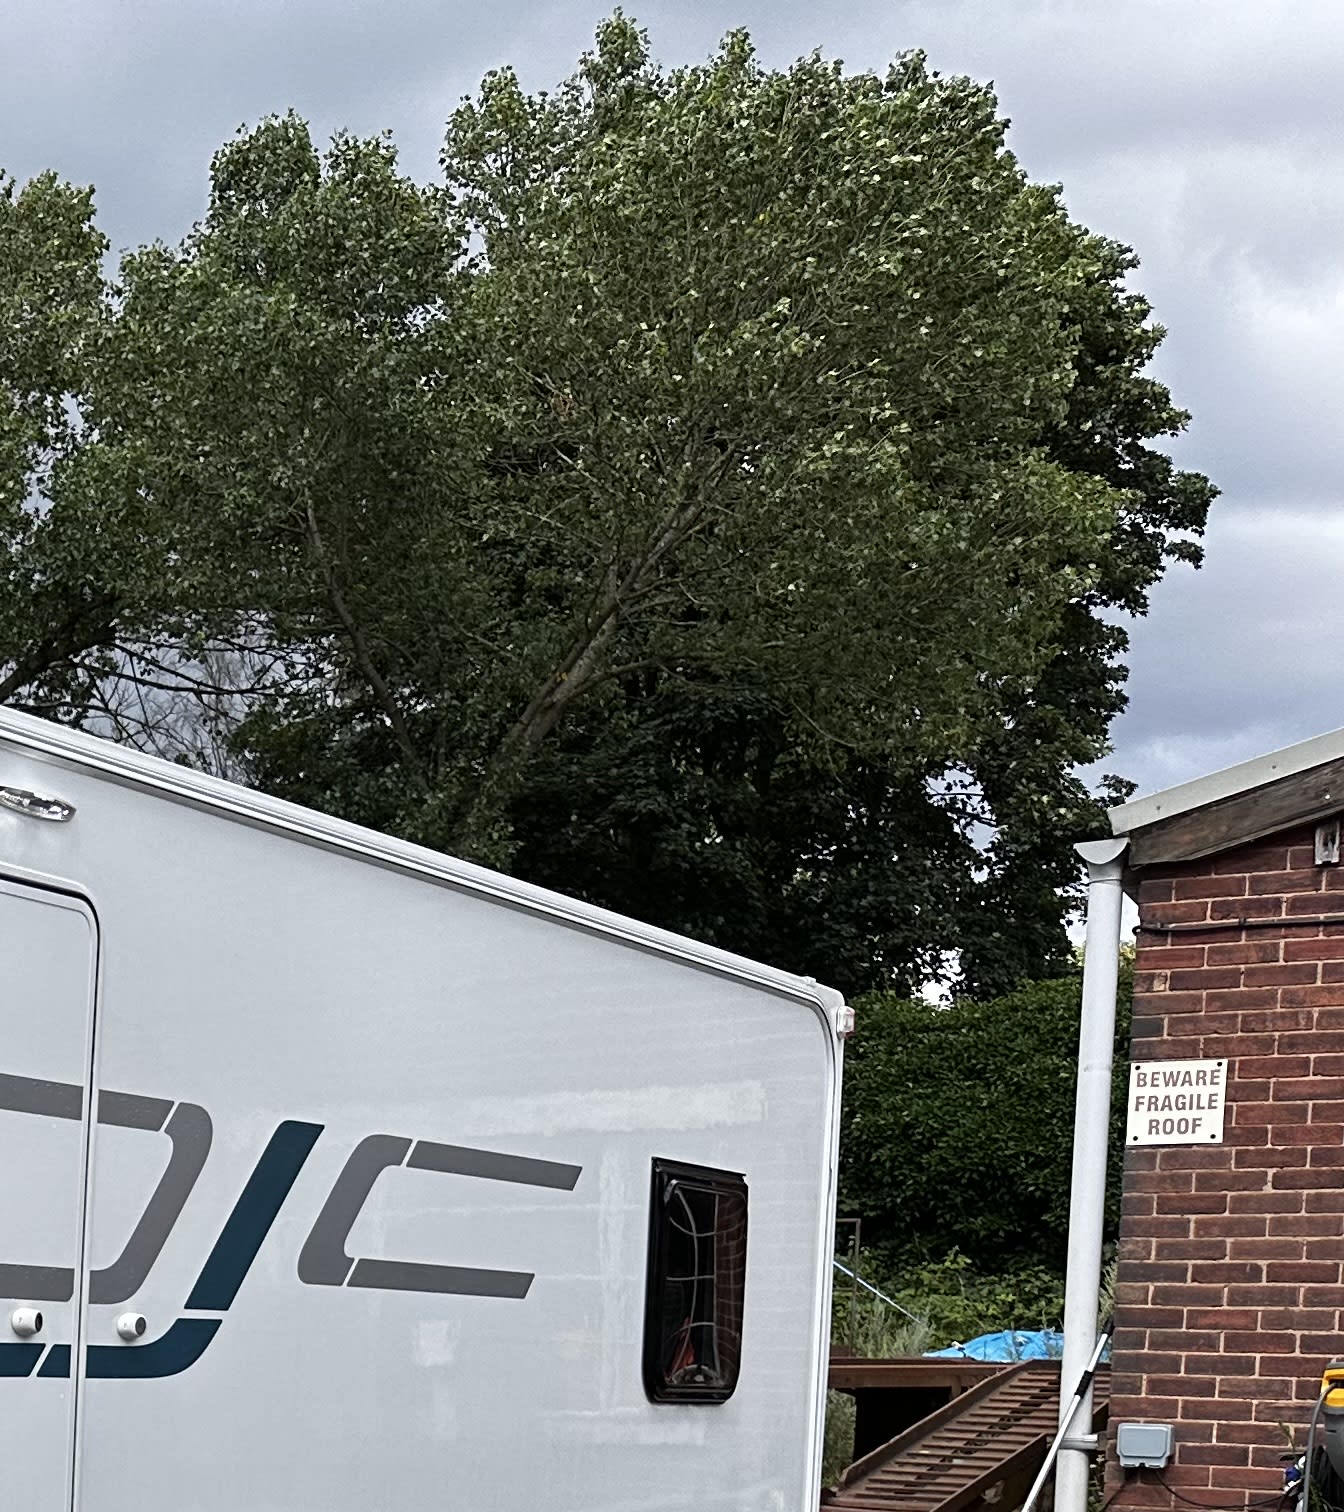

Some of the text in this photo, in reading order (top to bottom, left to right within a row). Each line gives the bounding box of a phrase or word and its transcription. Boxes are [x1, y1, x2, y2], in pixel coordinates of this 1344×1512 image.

[1136, 1069, 1221, 1088] BEWARE
[1134, 1093, 1219, 1112] FRAGILE
[1147, 1117, 1203, 1135] ROOF
